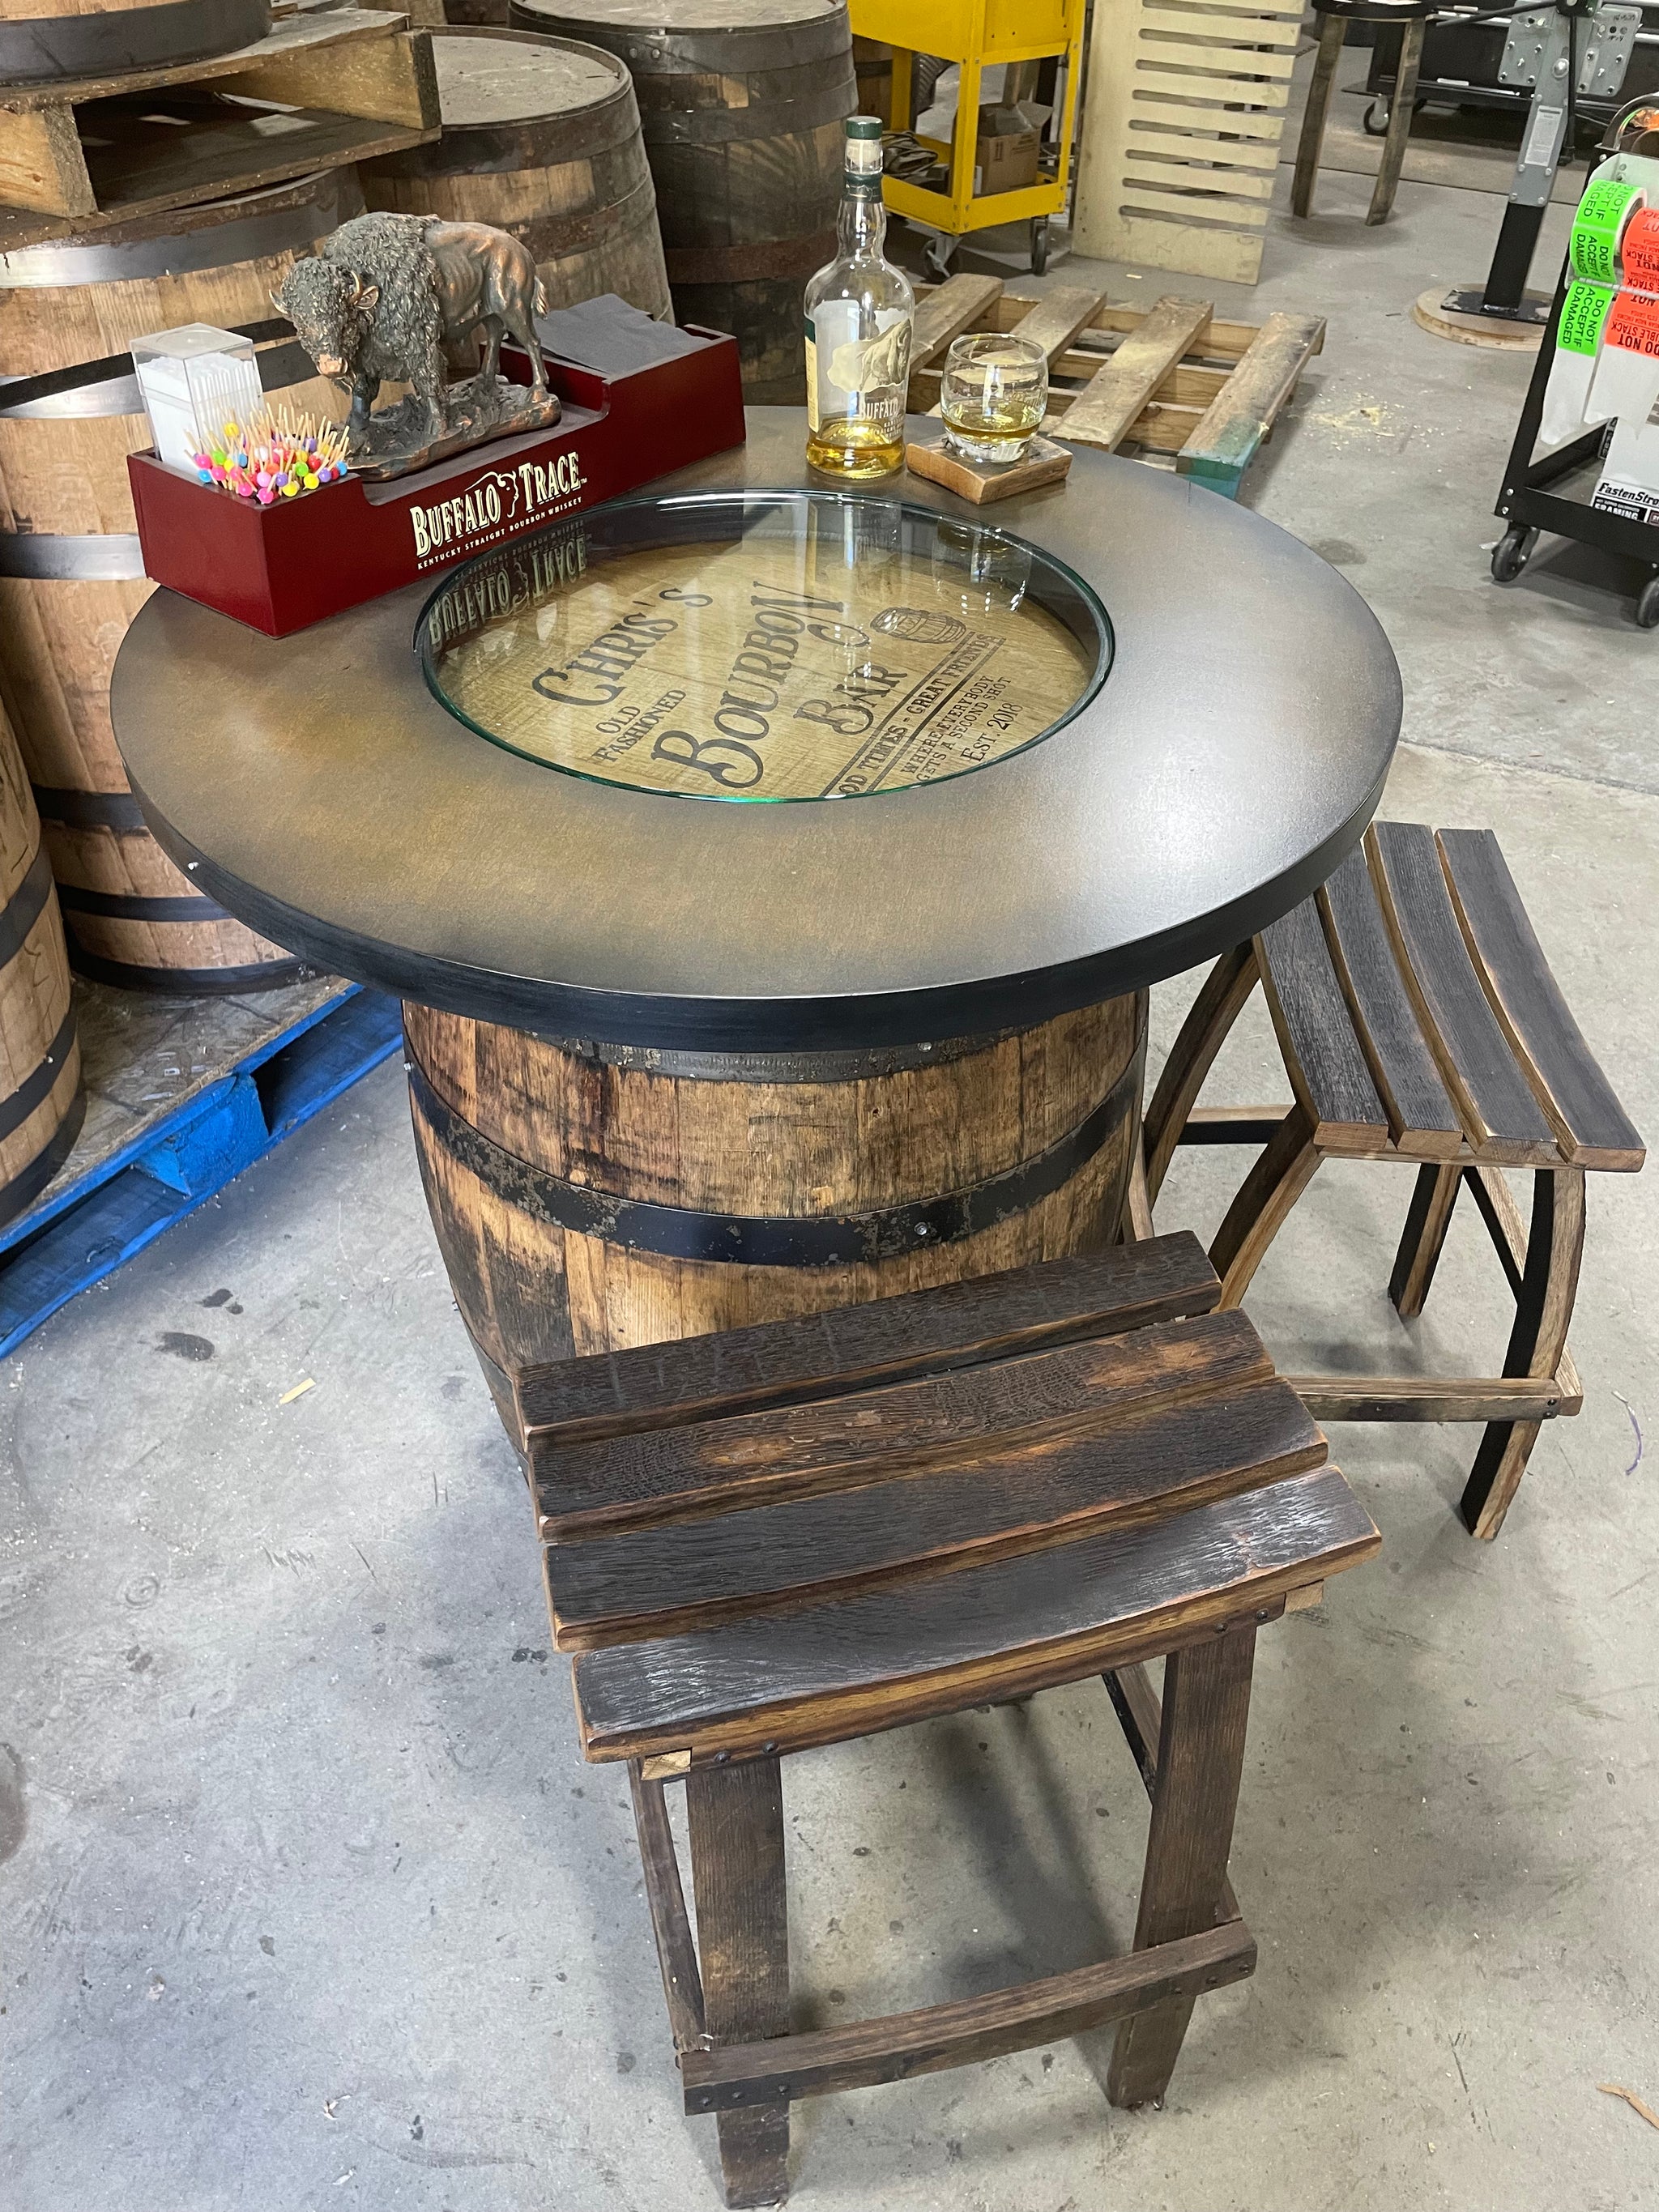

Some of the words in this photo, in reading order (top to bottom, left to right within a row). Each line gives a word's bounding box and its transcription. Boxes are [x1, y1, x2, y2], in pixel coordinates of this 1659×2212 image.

[1584, 182, 1610, 217] MAGED
[1601, 184, 1618, 207] EPT
[1610, 194, 1629, 215] NOT
[1596, 208, 1606, 220] IF
[1599, 246, 1609, 262] DO
[1627, 249, 1653, 262] STACK
[1627, 277, 1654, 291] STACK
[1563, 286, 1585, 344] DAMAGED
[1576, 287, 1596, 337] ACCEPT
[1592, 299, 1605, 318] DO
[1573, 338, 1582, 347] IF
[1585, 320, 1597, 344] NOT
[1611, 321, 1638, 336] STACK
[1617, 333, 1641, 350] NOT
[859, 396, 900, 421] BUFFALO
[1598, 482, 1659, 505] FastenStro
[410, 484, 501, 557] BUFFALO
[417, 547, 462, 570] KENTUCKY
[465, 528, 505, 551] STRAIGHT
[510, 512, 546, 532] BOURBON
[548, 497, 582, 516] WHISKEY
[531, 588, 713, 706] CHRIS'S
[650, 581, 870, 789] BOURBON
[793, 664, 908, 735] BAR
[857, 725, 908, 769] TIMES
[906, 678, 952, 716] GREAT
[940, 634, 999, 678] FRIENDS
[591, 689, 686, 762] FASHIONED
[595, 705, 641, 734] OLD
[901, 731, 944, 774] WHERE
[936, 676, 994, 731] EVERYBODY
[916, 752, 947, 782] GETS
[940, 741, 956, 751] A
[950, 702, 989, 739] SECOND
[983, 677, 1011, 701] SHOT
[960, 732, 1000, 761] EST.
[987, 702, 1023, 731] 2018
